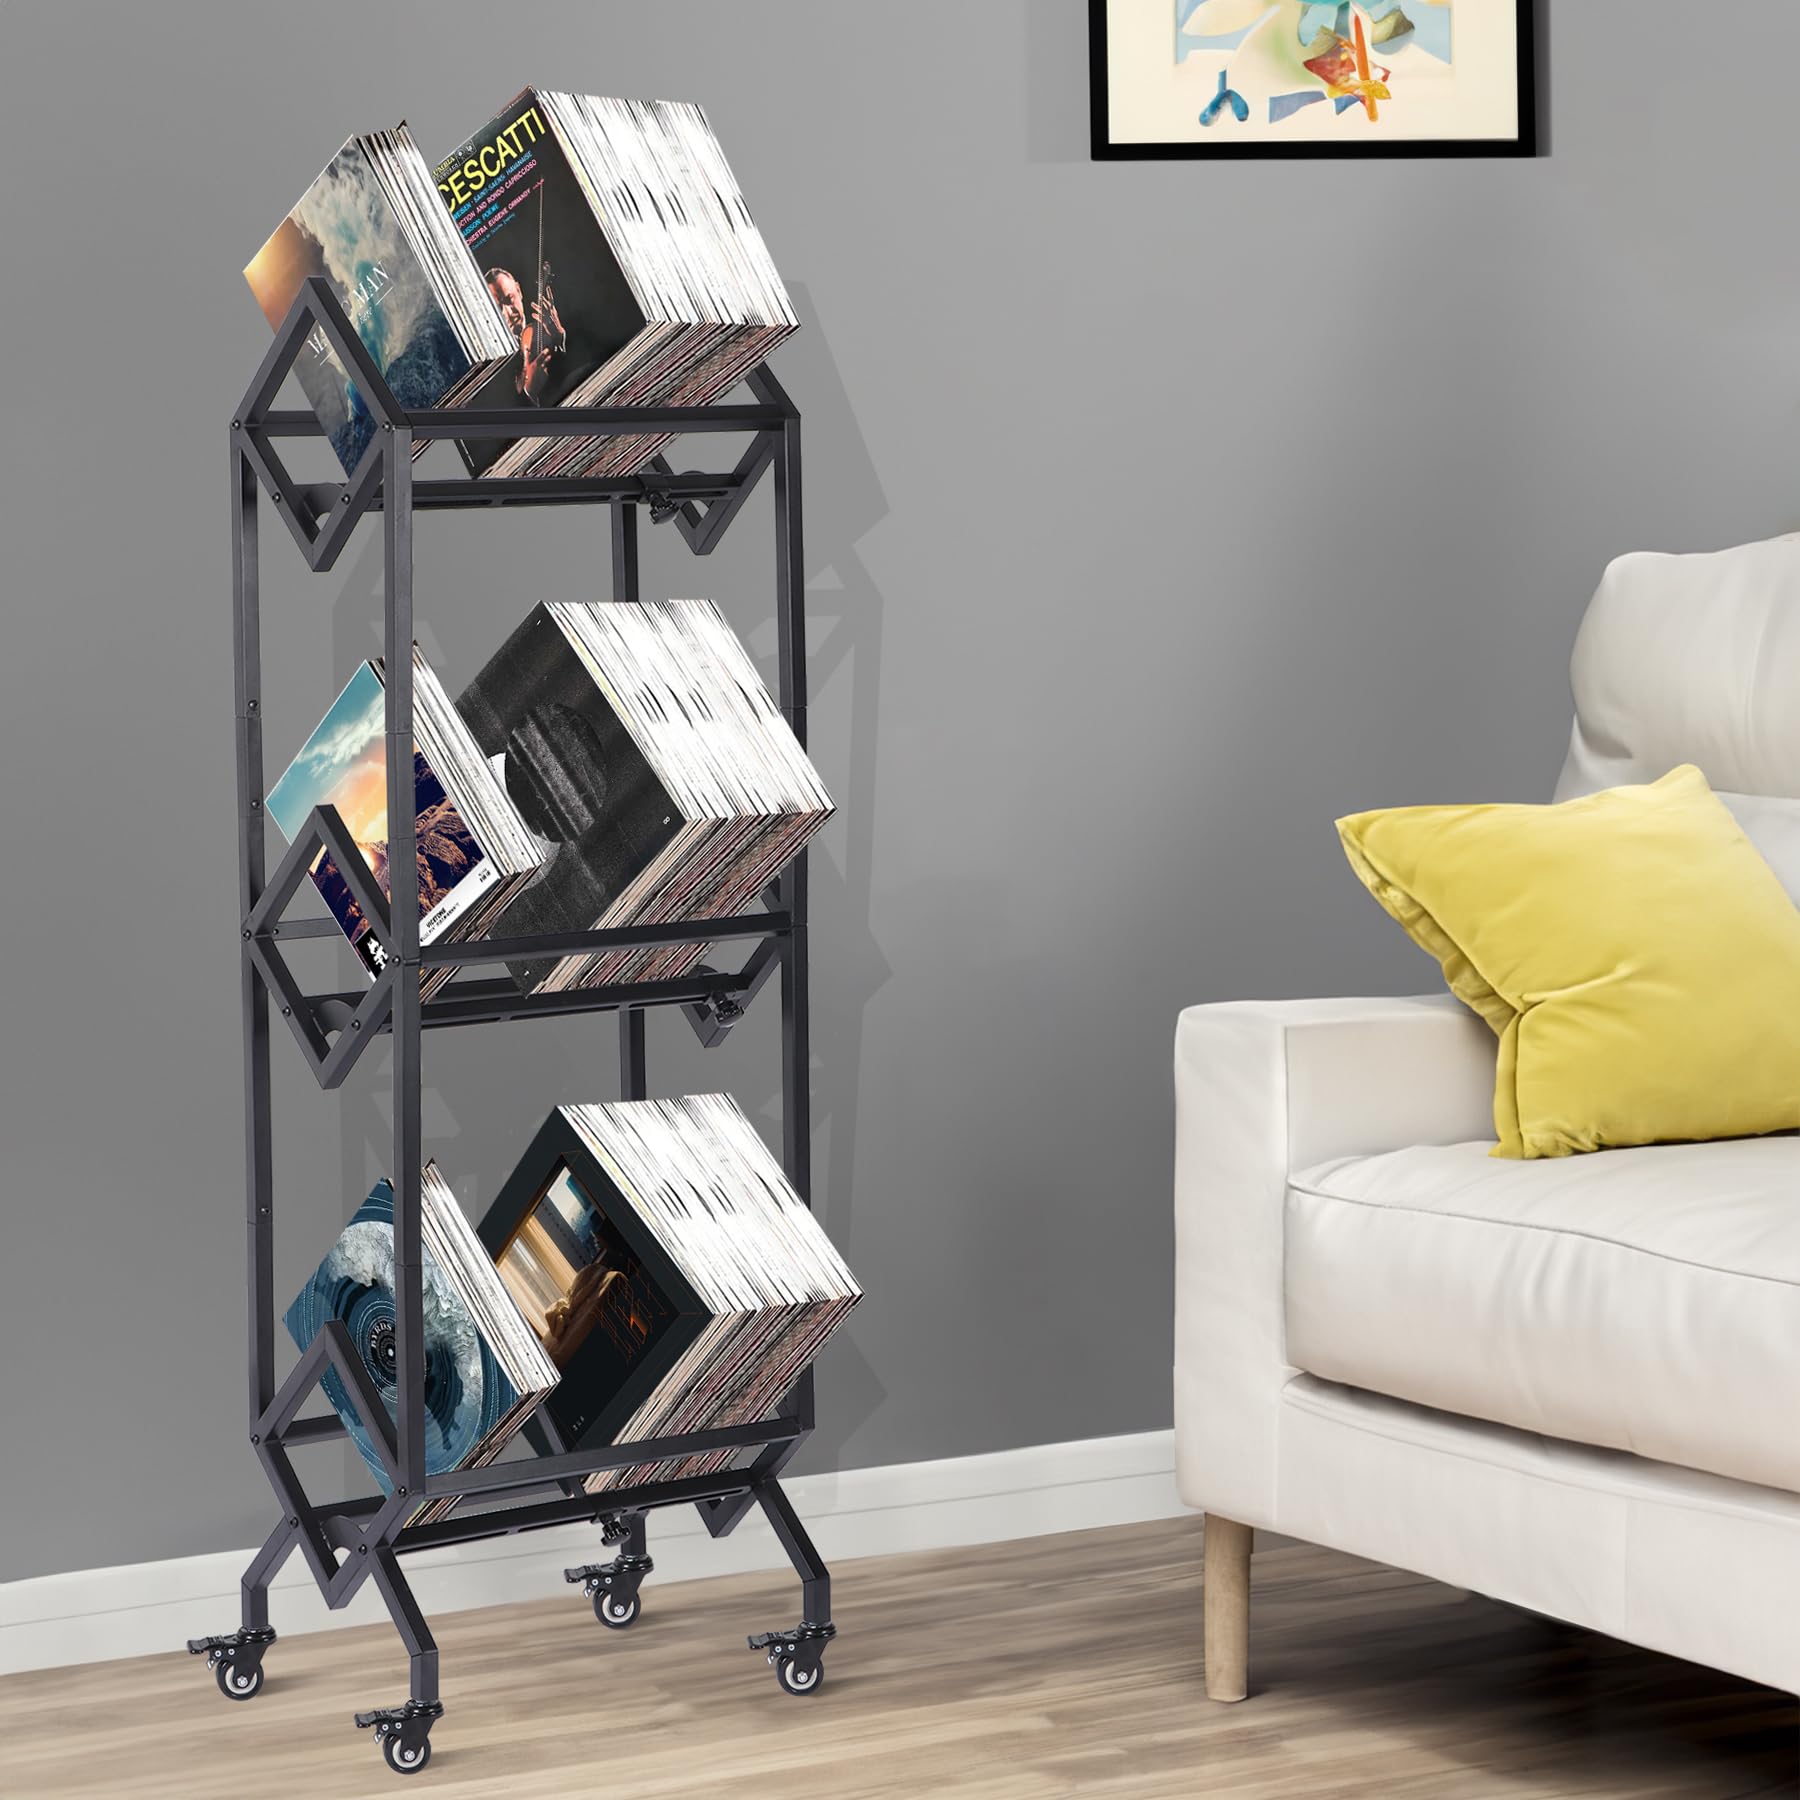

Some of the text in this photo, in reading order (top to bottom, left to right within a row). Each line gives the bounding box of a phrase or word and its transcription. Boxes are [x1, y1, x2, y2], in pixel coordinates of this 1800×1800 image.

[476, 201, 488, 214] AND
[486, 186, 505, 204] RONDO
[505, 159, 537, 189] CAPRICCIOSO
[488, 207, 509, 227] EUGENE
